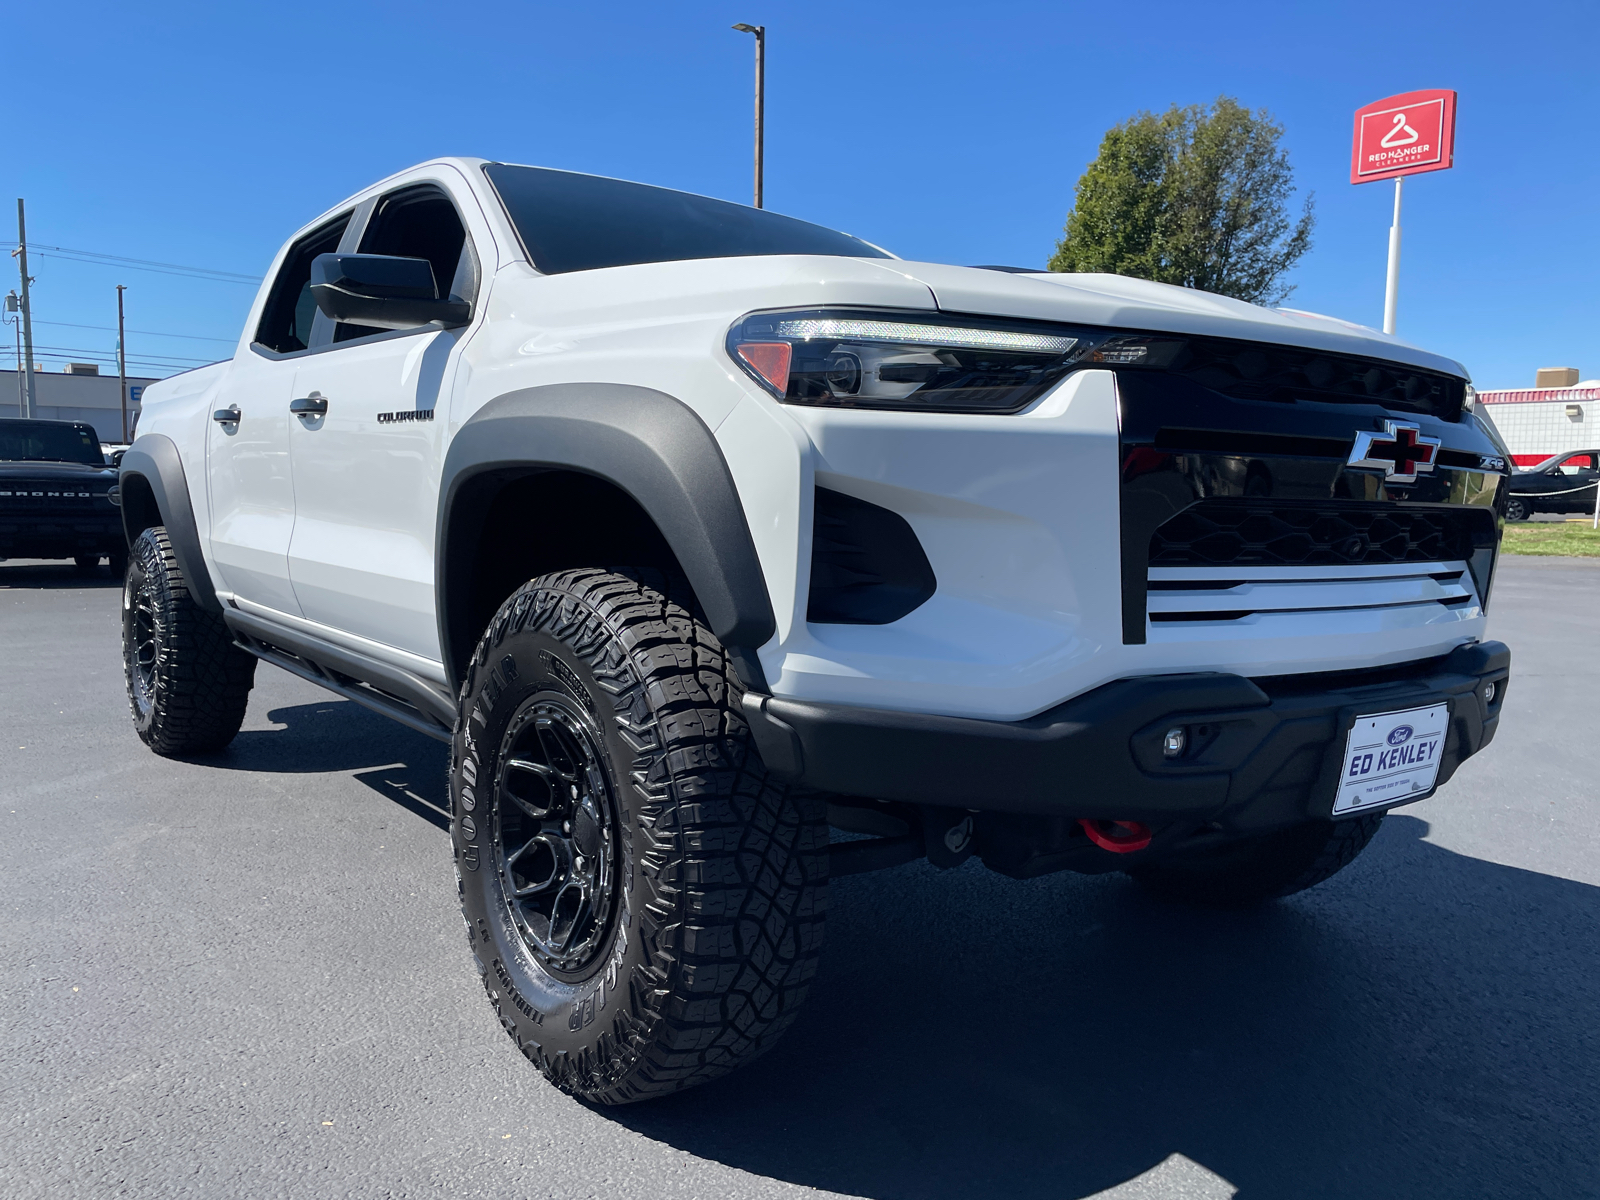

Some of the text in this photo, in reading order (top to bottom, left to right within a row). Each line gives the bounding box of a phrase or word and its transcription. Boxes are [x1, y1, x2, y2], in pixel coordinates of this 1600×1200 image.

[1369, 144, 1430, 162] RED HANGER
[1376, 154, 1421, 167] CLEANERS
[377, 408, 435, 422] COLORADO
[1349, 740, 1438, 777] ED KENLEY
